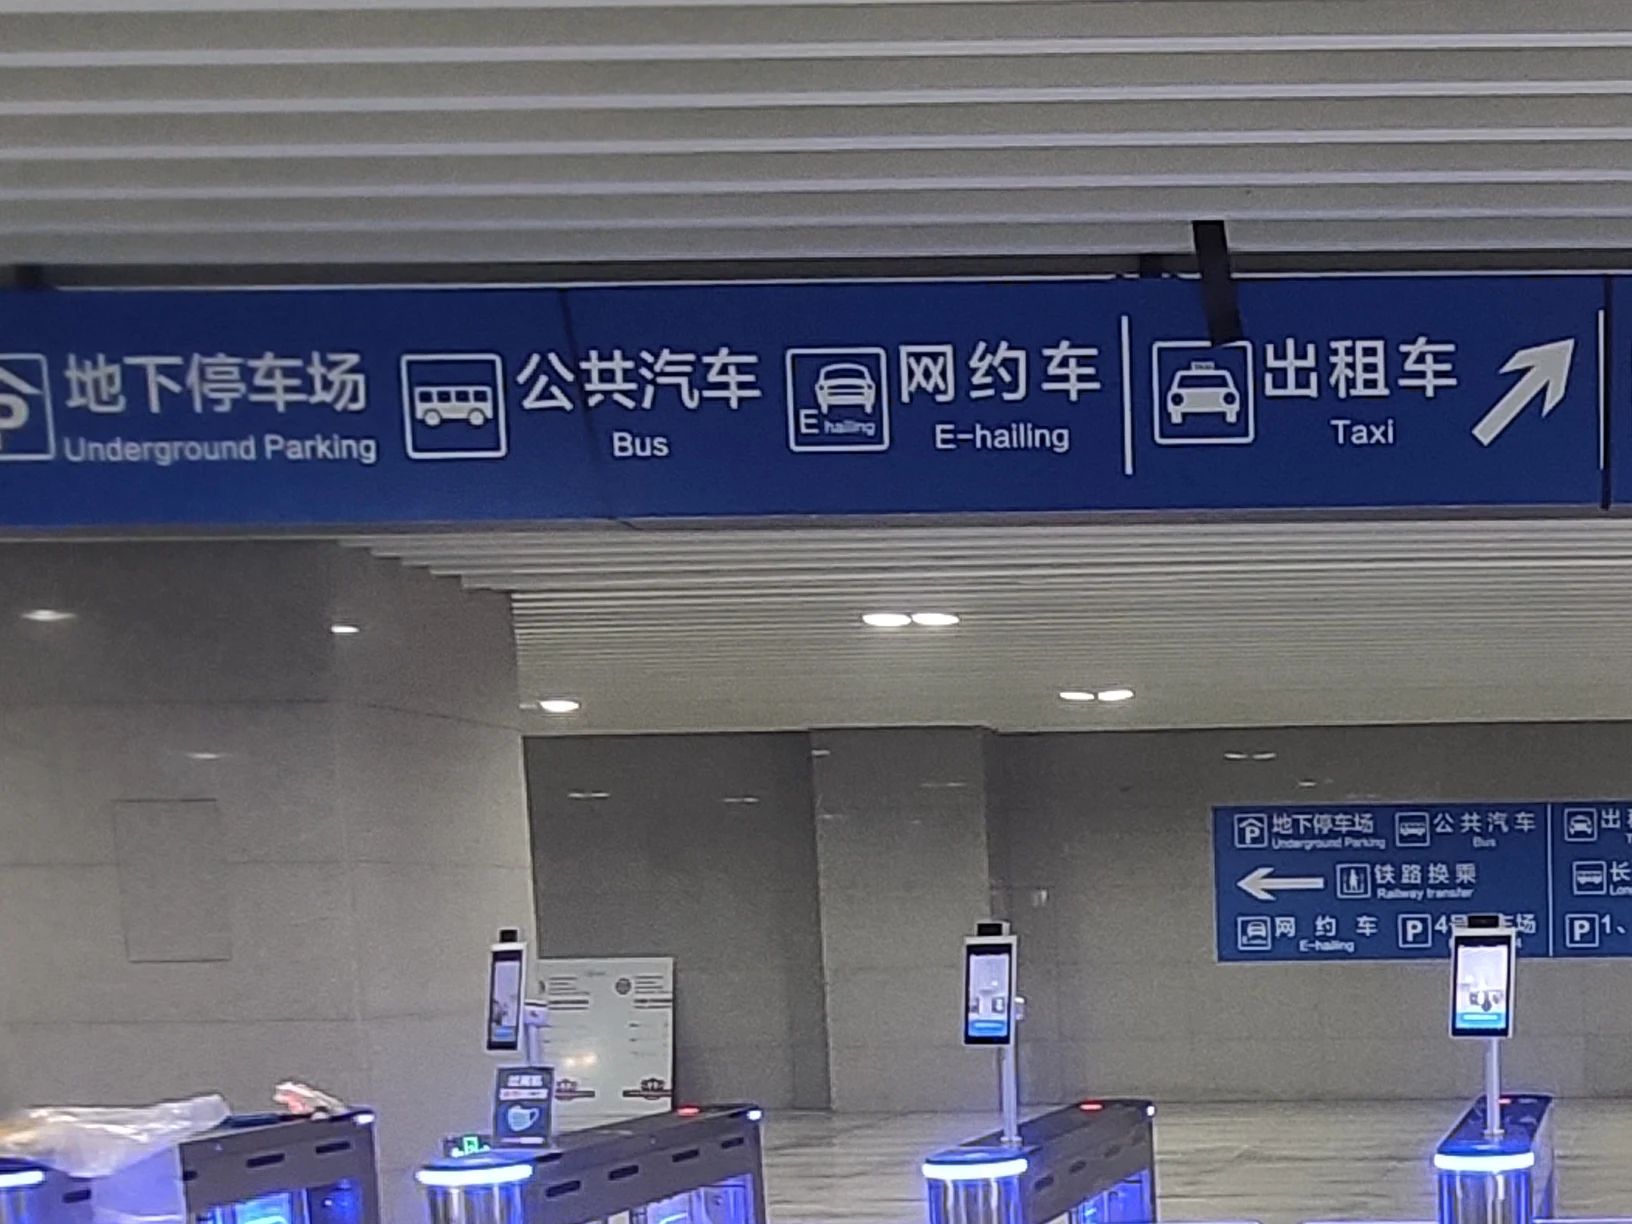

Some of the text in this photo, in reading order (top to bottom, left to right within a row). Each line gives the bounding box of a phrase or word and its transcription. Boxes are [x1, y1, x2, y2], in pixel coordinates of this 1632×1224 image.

[517, 347, 761, 410] 公共汽车
[899, 341, 1100, 403] 网约车
[1265, 337, 1457, 398] 出租车
[65, 352, 365, 413] 地下停车场
[936, 423, 1069, 452] E-hailing
[1331, 419, 1393, 444] Taxi
[64, 434, 376, 466] Underground Parking
[613, 432, 668, 456] Bus
[1272, 813, 1373, 834] 地下停车场
[1434, 812, 1535, 832] 公共汽车
[1272, 837, 1385, 850] Underground Parking
[1473, 836, 1496, 847] Bus
[1374, 863, 1475, 883] 铁路换乘
[1377, 888, 1423, 900] Railway
[1275, 916, 1377, 937] 网约车
